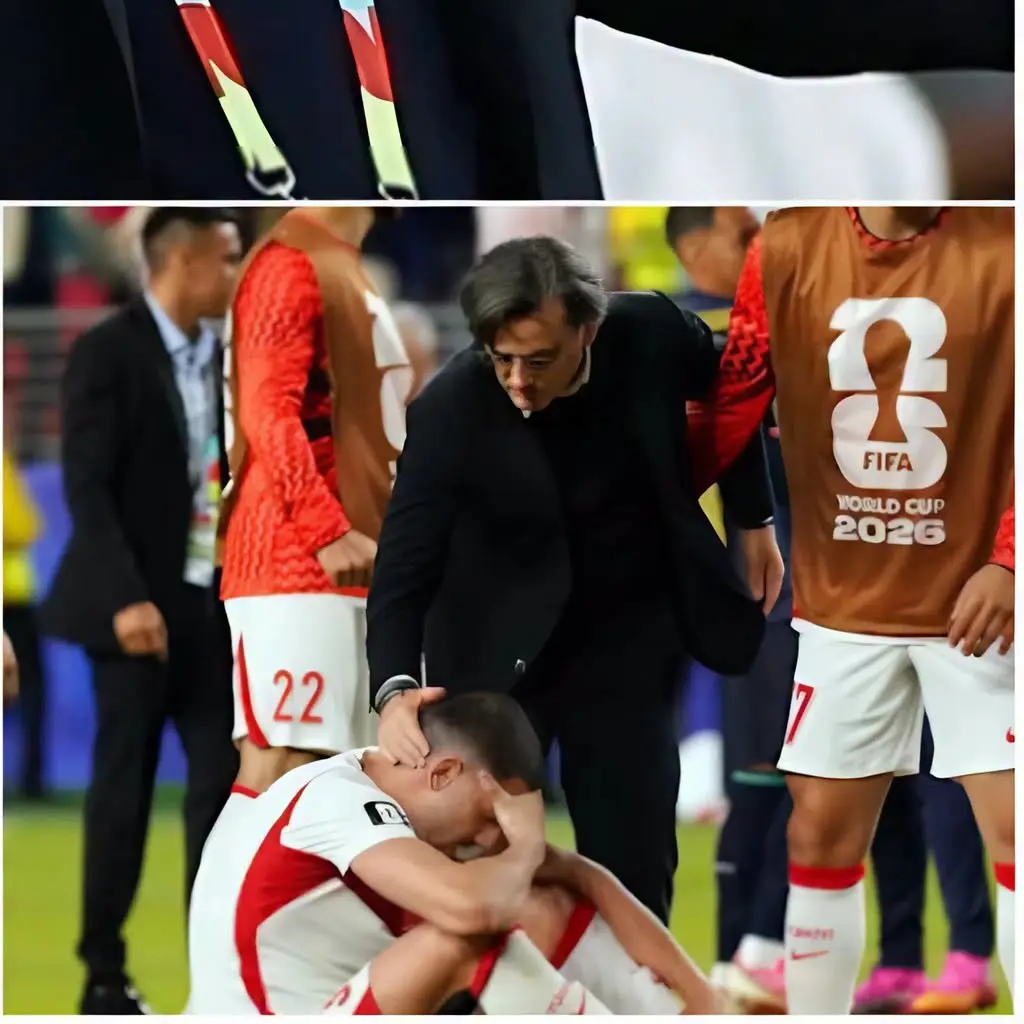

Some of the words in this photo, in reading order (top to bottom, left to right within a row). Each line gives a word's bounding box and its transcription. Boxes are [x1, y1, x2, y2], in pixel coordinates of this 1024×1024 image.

[863, 451, 913, 471] FIFA
[836, 494, 901, 515] WORLD
[904, 498, 945, 515] CUP
[832, 514, 946, 546] 2026
[272, 669, 325, 725] 22
